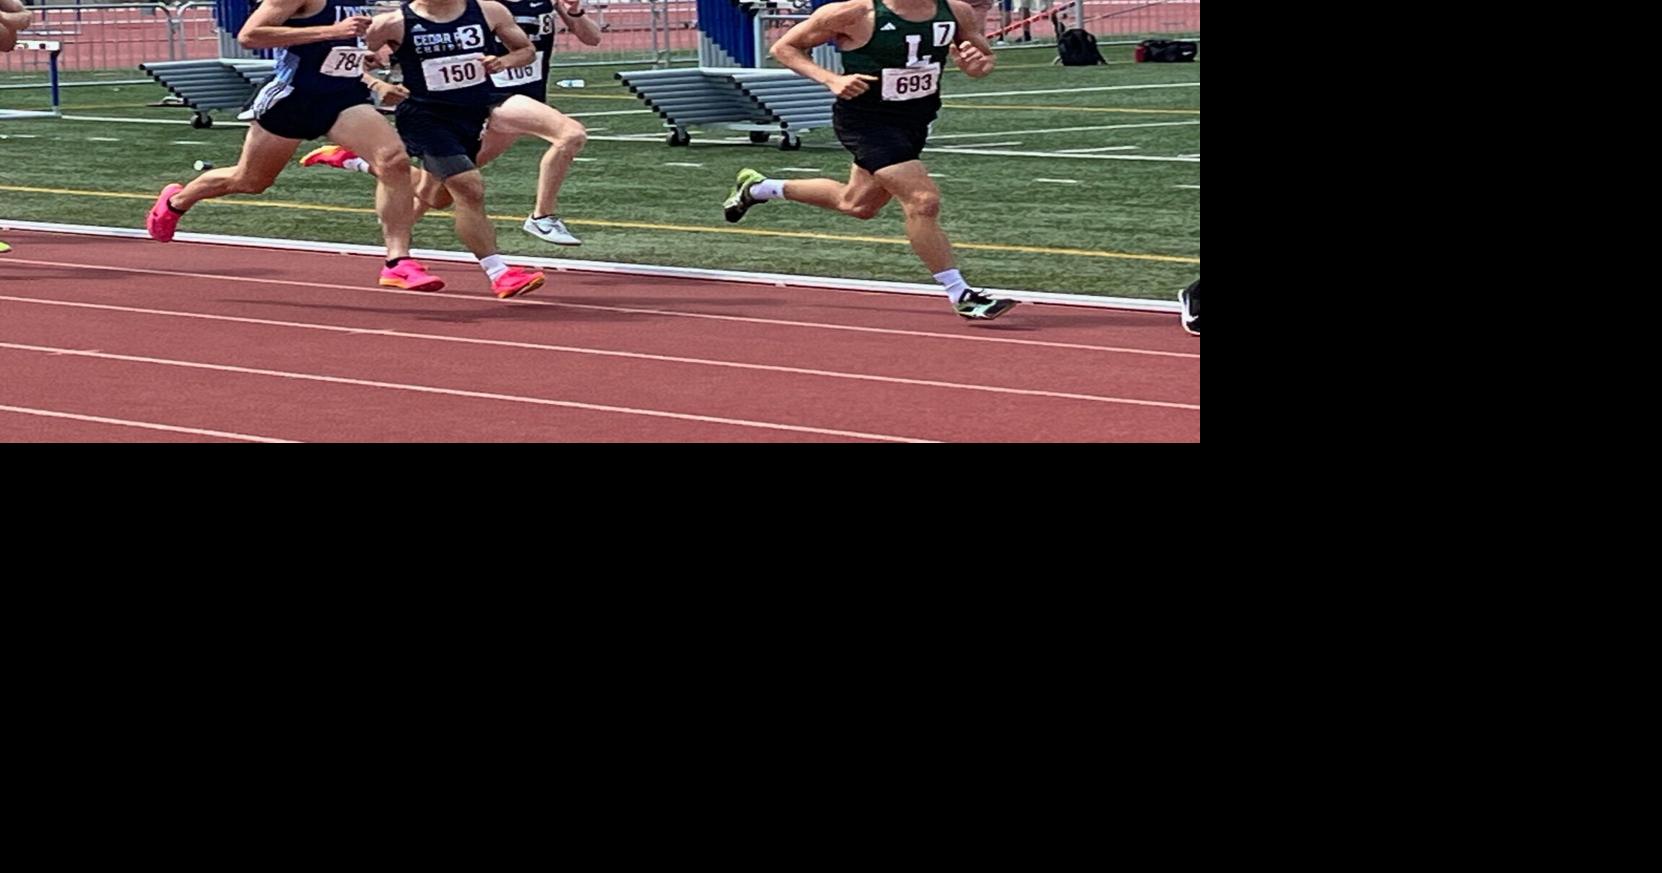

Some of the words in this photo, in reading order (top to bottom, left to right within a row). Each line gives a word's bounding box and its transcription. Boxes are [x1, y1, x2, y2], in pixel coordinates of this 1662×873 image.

[542, 14, 552, 33] 8
[413, 32, 452, 46] CEDAR
[461, 27, 481, 47] 3
[938, 24, 951, 45] 7
[905, 34, 932, 68] L
[438, 62, 476, 84] 150
[896, 73, 932, 94] 693
